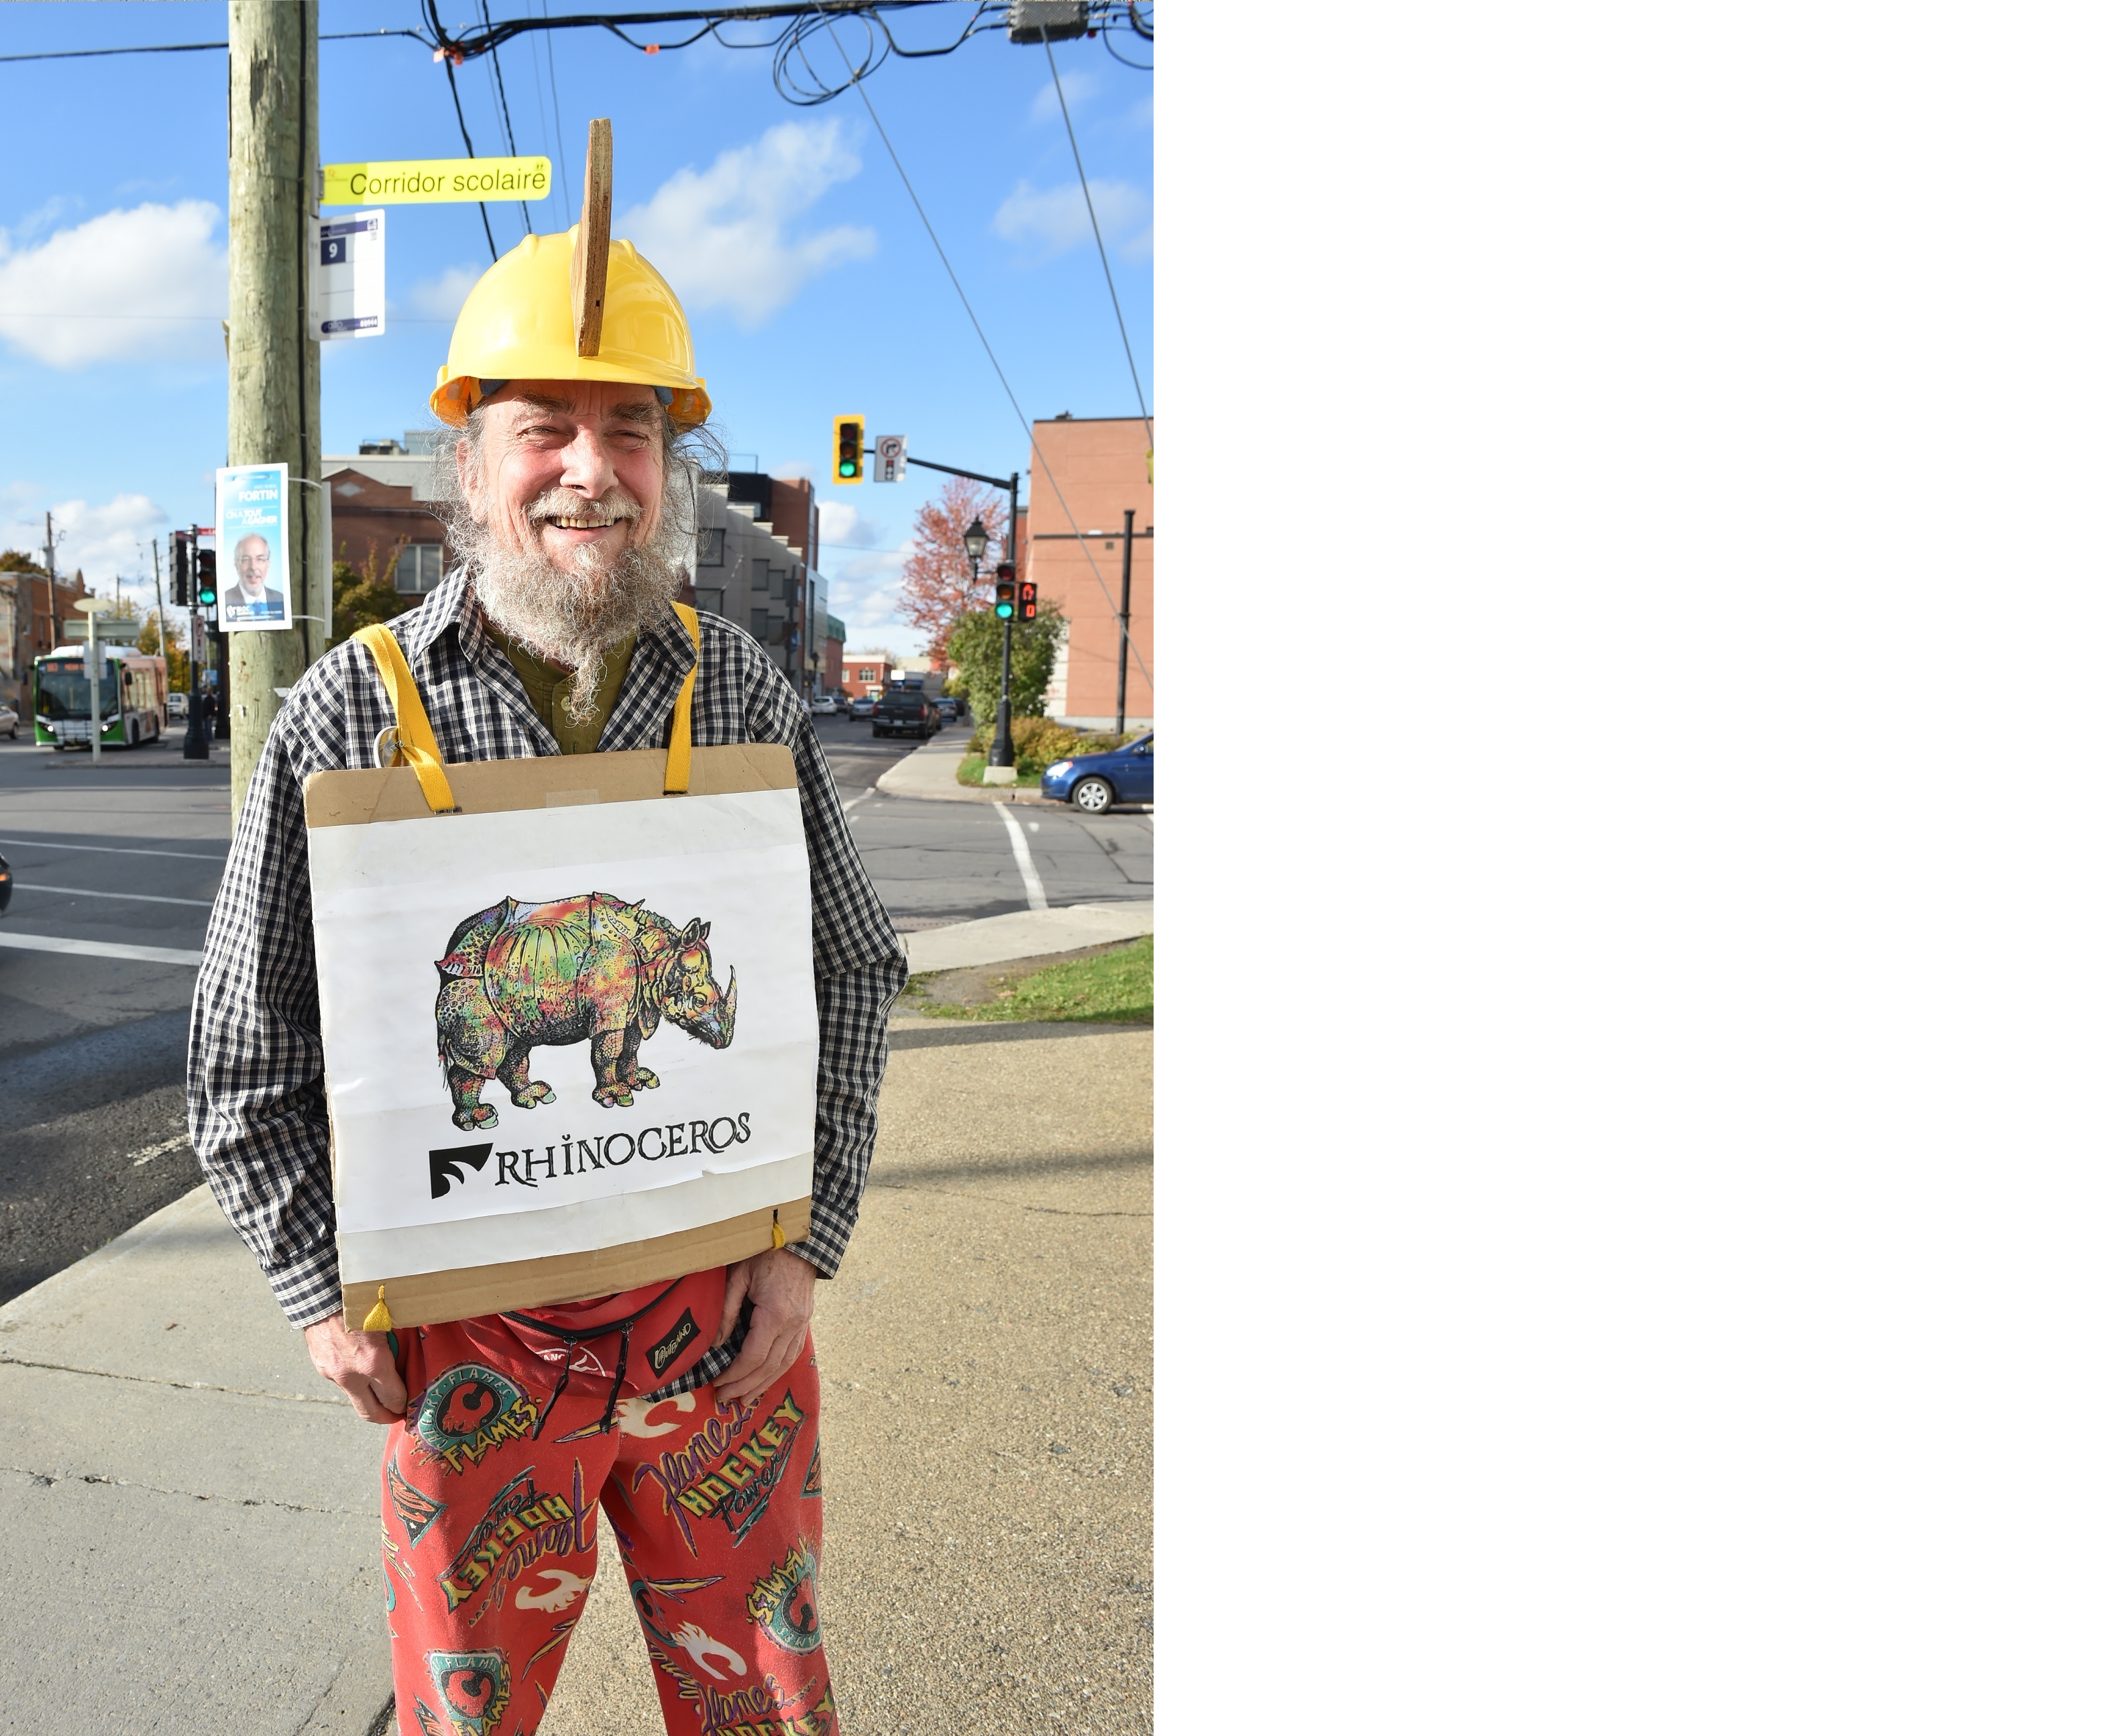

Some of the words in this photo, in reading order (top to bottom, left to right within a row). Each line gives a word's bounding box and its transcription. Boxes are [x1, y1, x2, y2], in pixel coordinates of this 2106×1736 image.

[351, 172, 445, 195] Corridor
[453, 168, 545, 191] scolaire
[329, 242, 338, 258] 9
[238, 489, 278, 502] FORTIN
[449, 1368, 512, 1399] FLAMES
[442, 1397, 537, 1476] FLAMES
[675, 1388, 804, 1520] HOCKEY
[440, 1493, 575, 1614] HOCKEY
[445, 1657, 498, 1672] FLAMES
